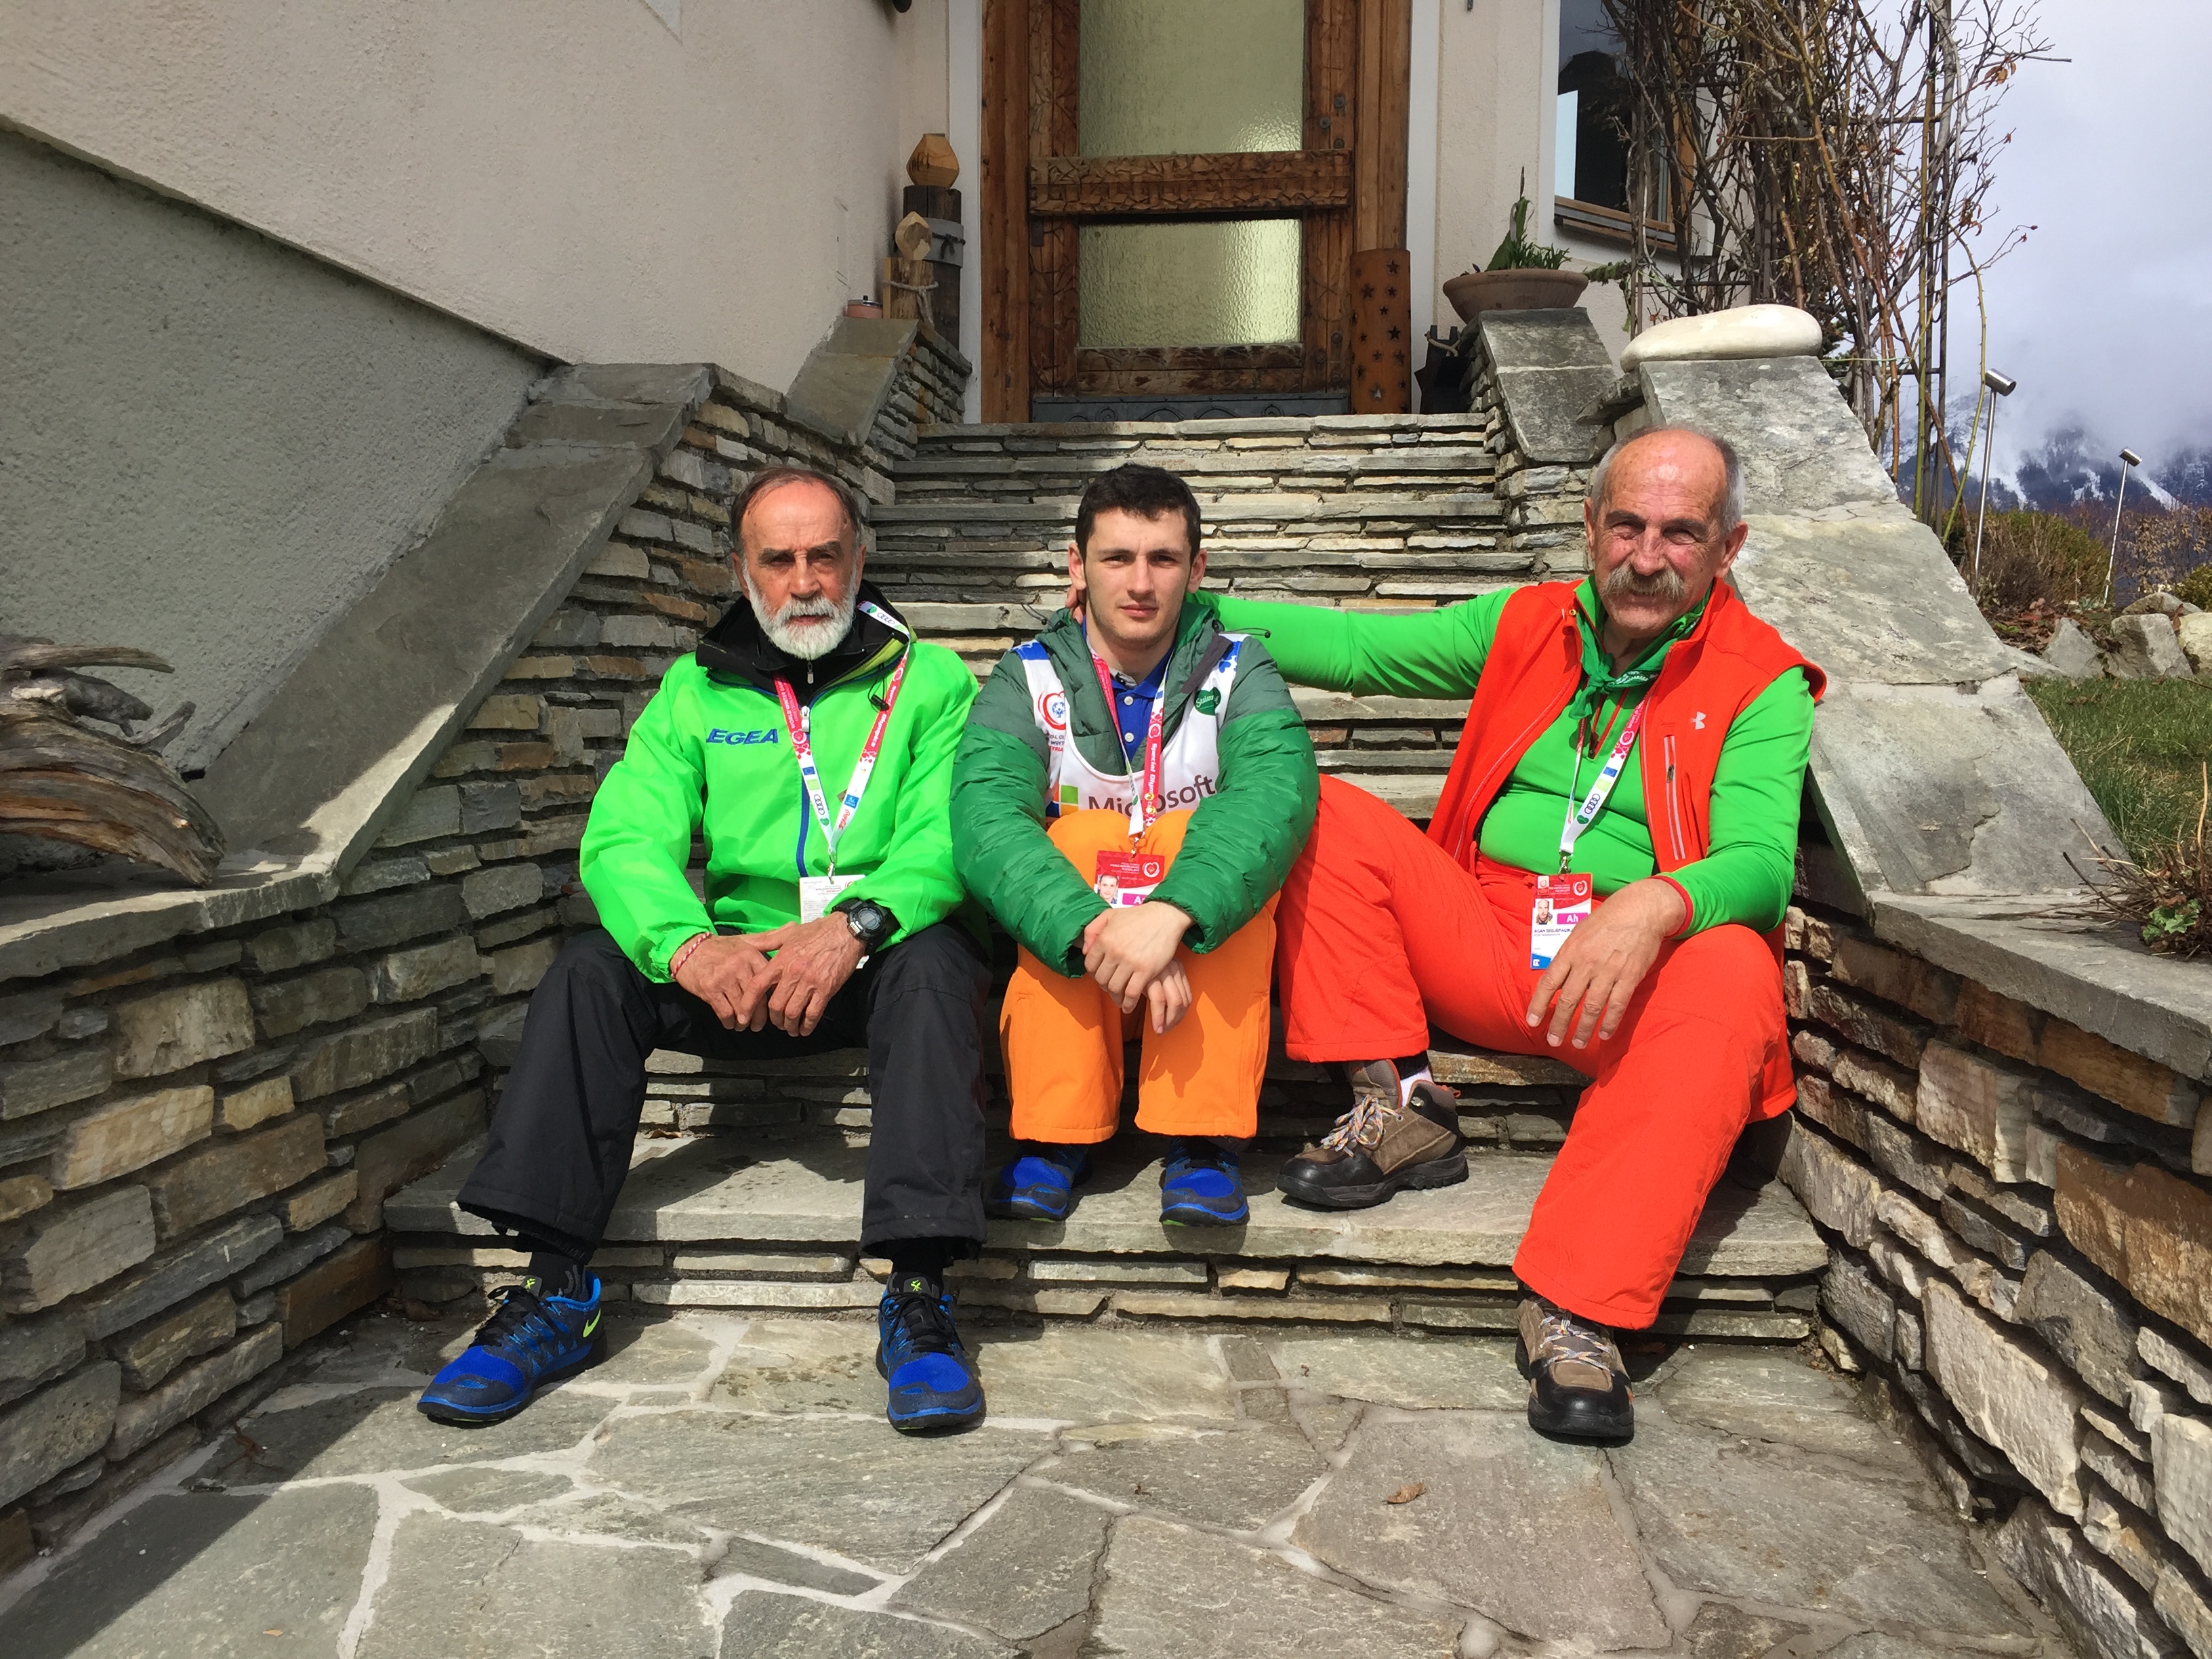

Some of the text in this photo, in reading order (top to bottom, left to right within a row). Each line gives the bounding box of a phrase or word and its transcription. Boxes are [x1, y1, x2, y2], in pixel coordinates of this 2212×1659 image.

[706, 729, 778, 745] EGEA
[1088, 775, 1216, 818] Micosoft
[1566, 914, 1579, 922] Ah
